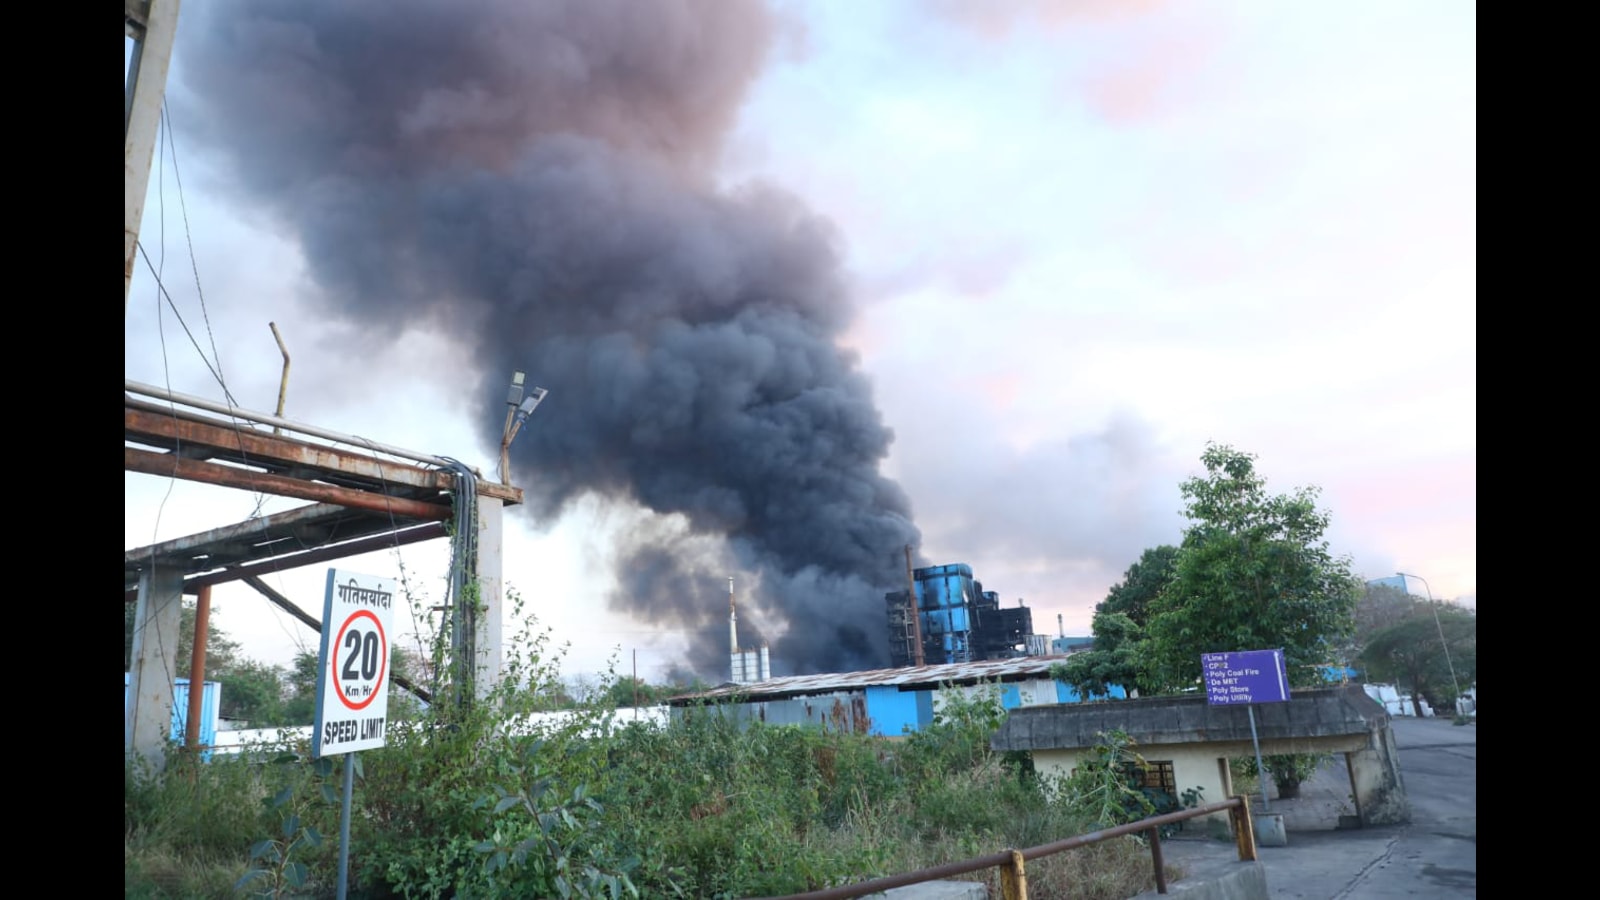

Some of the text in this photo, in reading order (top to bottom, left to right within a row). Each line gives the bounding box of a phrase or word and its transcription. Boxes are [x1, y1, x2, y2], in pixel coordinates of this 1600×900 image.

[338, 578, 392, 610] गतिमर्यादा
[342, 629, 378, 681] 20
[1213, 694, 1252, 703] Poly Utility
[324, 717, 384, 744] SPEED LIMIT
